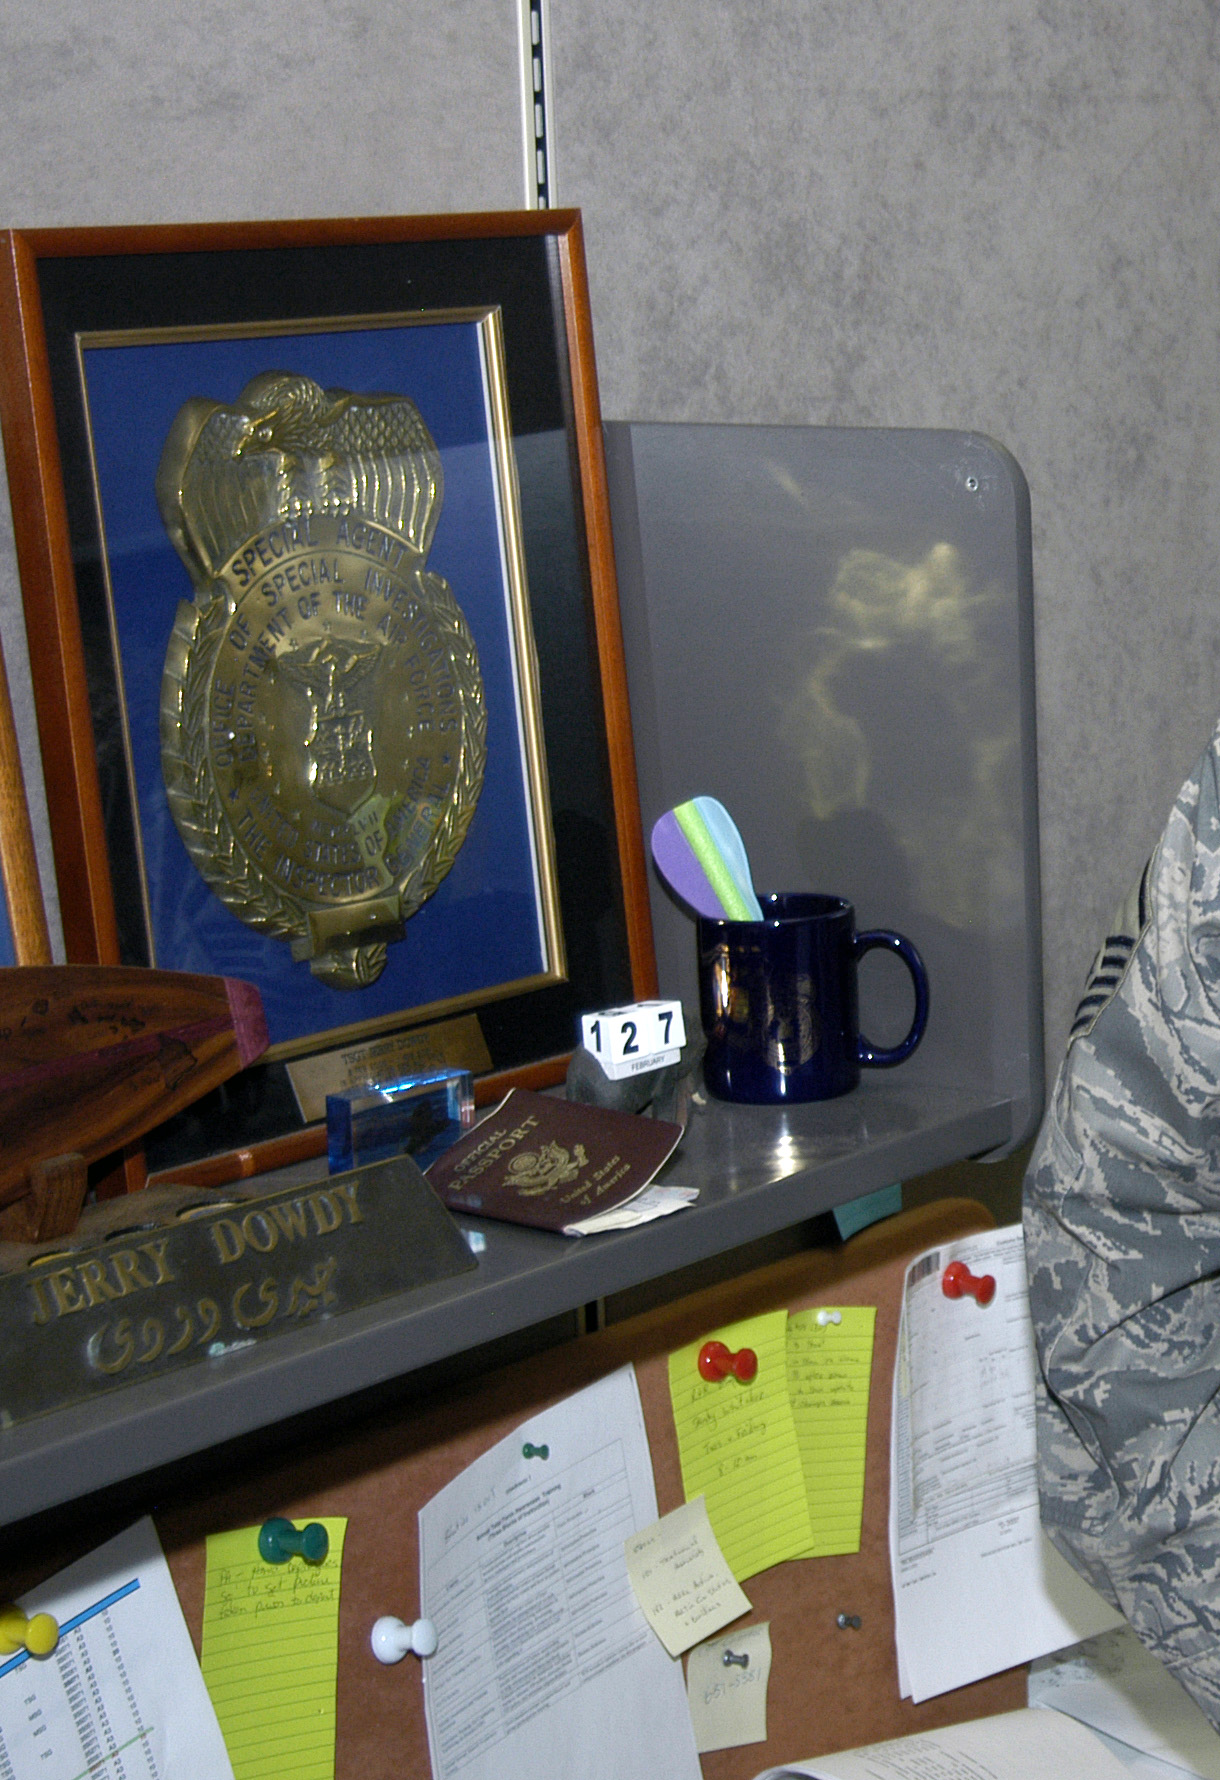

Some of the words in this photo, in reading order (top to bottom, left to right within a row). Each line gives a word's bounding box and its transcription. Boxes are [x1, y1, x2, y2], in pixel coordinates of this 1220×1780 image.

[231, 520, 320, 587] SPECIAL
[337, 520, 408, 570] AGENT
[212, 679, 235, 768] OFFICE
[229, 620, 252, 653] OF
[261, 558, 345, 611] SPECIAL
[235, 609, 293, 763] DEPARTMENT
[298, 592, 322, 620] OF
[333, 590, 366, 621] THE
[377, 608, 409, 645] AIR
[237, 809, 272, 860] THE
[275, 857, 381, 897] INSPECTOR
[304, 840, 362, 867] STATES
[364, 829, 384, 857] OF
[631, 1055, 666, 1073] FEBRUARY
[448, 1114, 540, 1191] PASSPORT
[453, 1129, 507, 1173] OFFICIAL
[25, 1237, 176, 1325] JERRY
[211, 1180, 366, 1265] DOWDY
